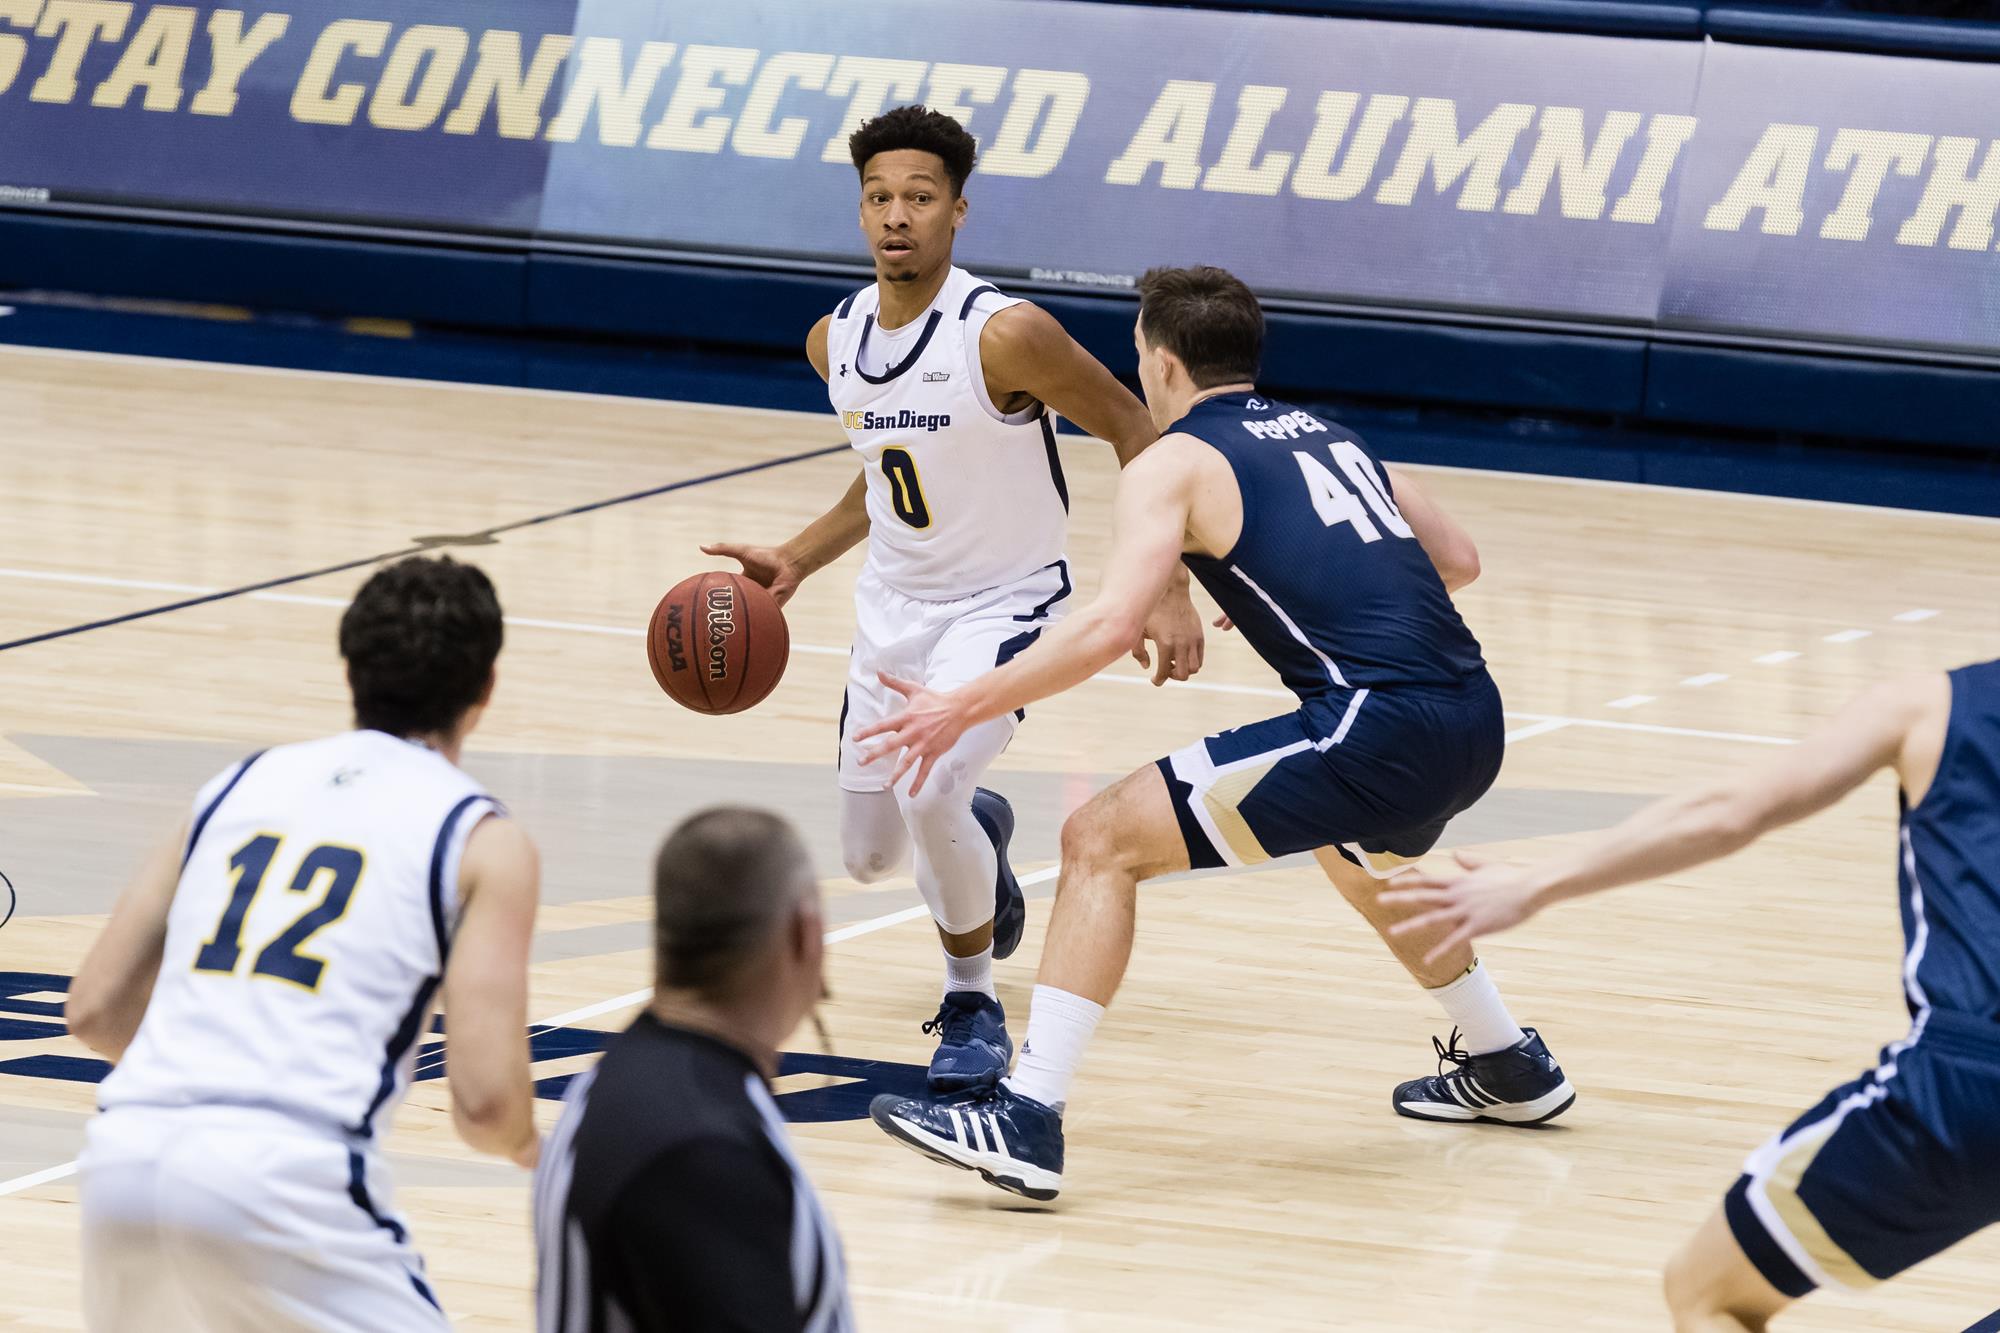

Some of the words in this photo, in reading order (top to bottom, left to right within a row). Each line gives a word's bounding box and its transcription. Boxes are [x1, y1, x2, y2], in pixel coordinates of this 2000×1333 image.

[1105, 79, 1698, 225] ALUMNI
[880, 444, 933, 533] 0
[1292, 440, 1417, 544] 40
[666, 604, 688, 673] NCAA
[706, 585, 736, 682] Wilson
[192, 831, 367, 995] 12
